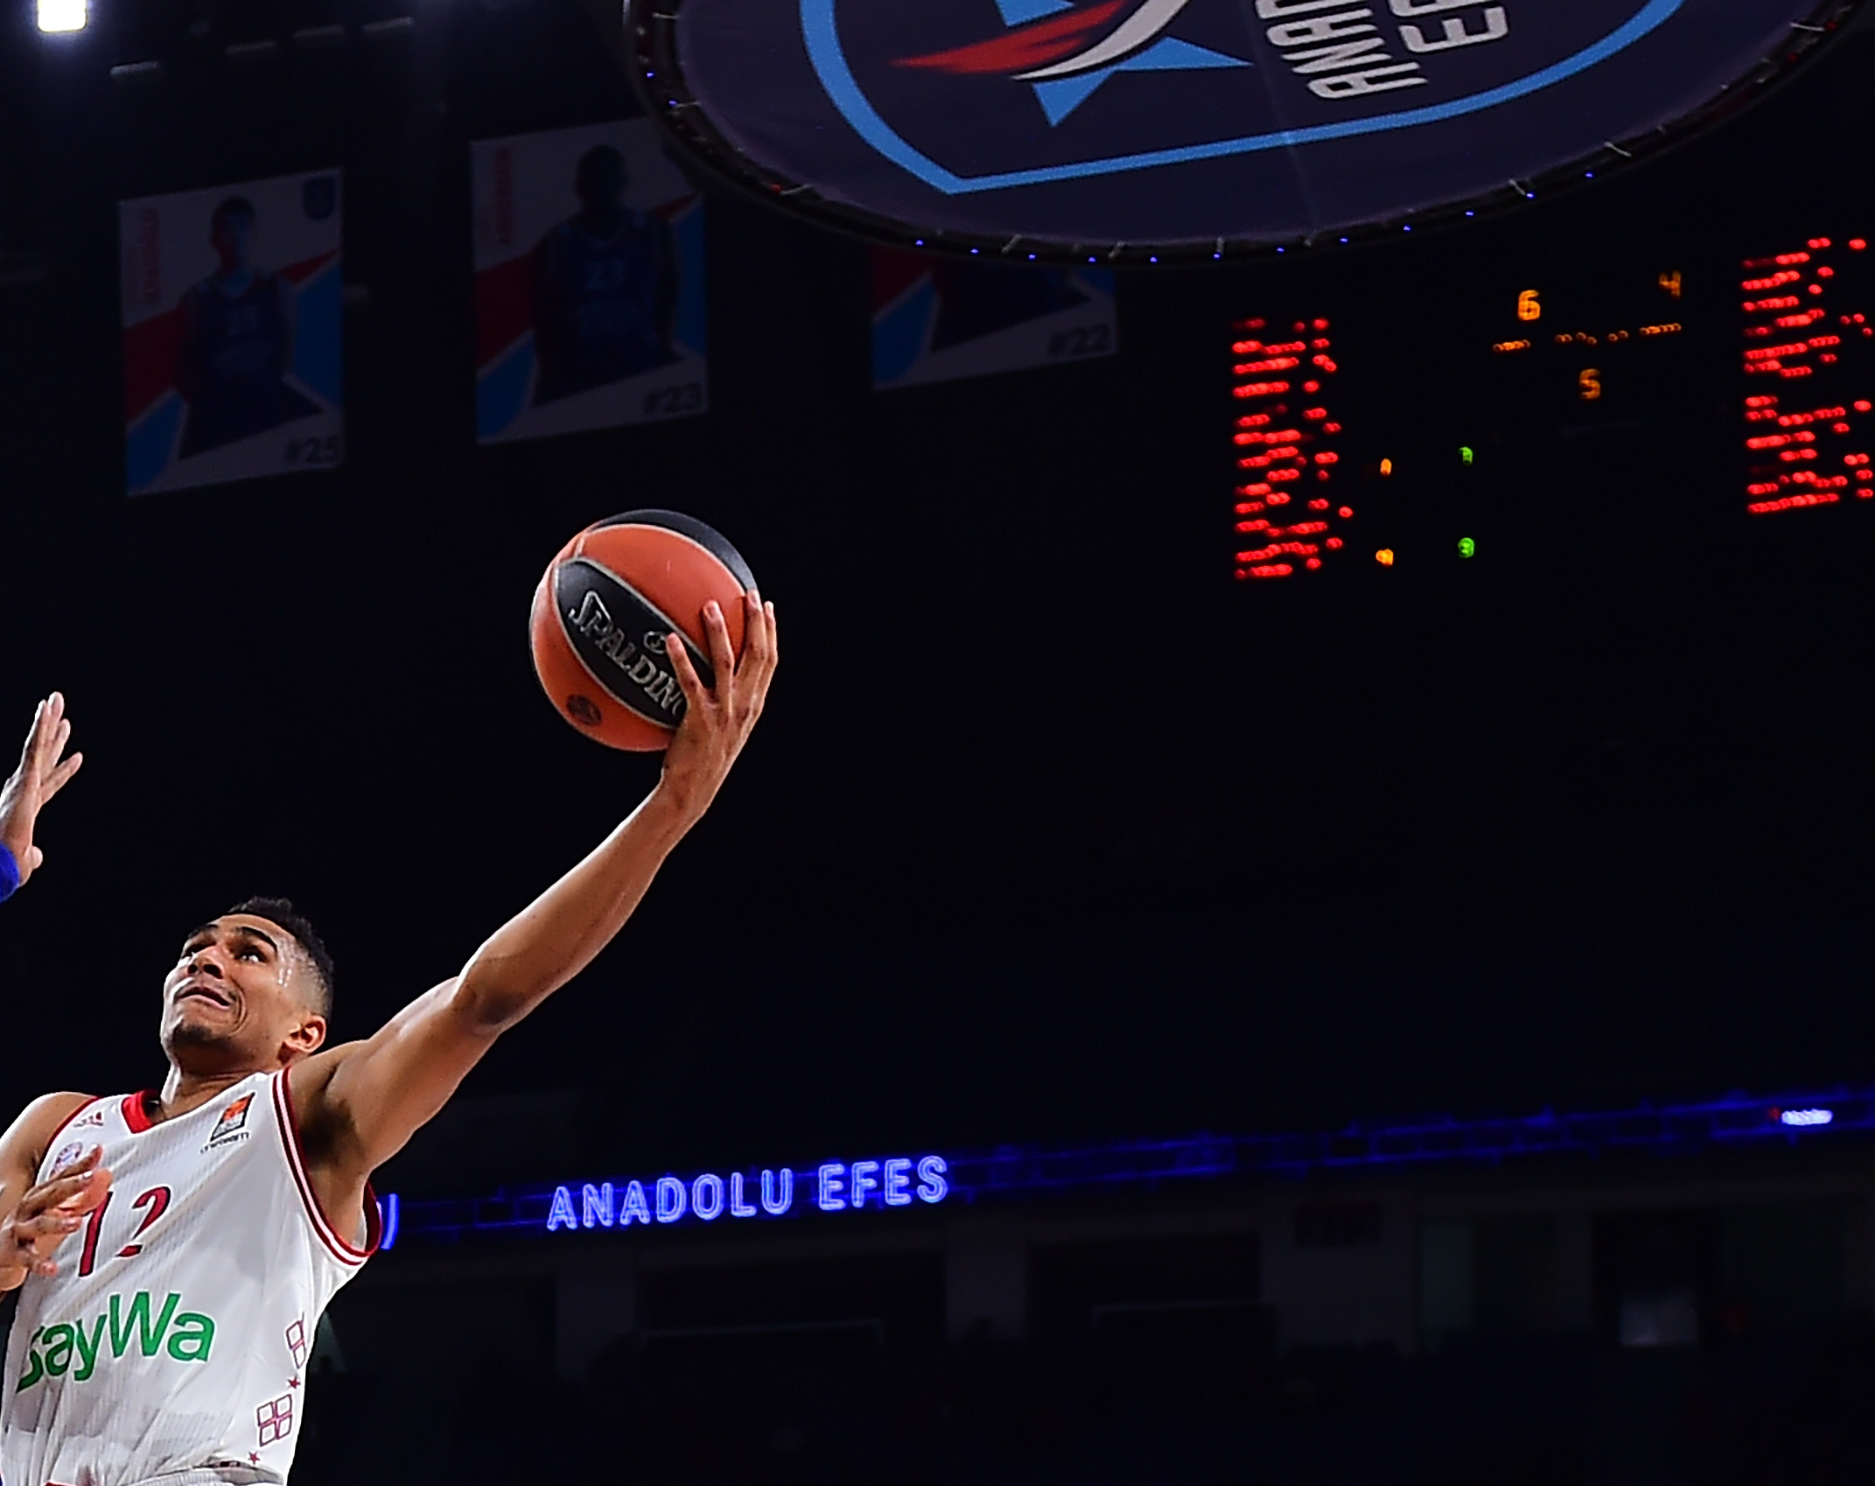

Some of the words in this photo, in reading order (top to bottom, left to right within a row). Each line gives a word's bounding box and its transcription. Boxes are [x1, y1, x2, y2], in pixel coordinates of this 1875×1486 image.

[1517, 289, 1541, 321] 6
[546, 1168, 794, 1232] ANADOLU
[817, 1154, 949, 1212] EFES
